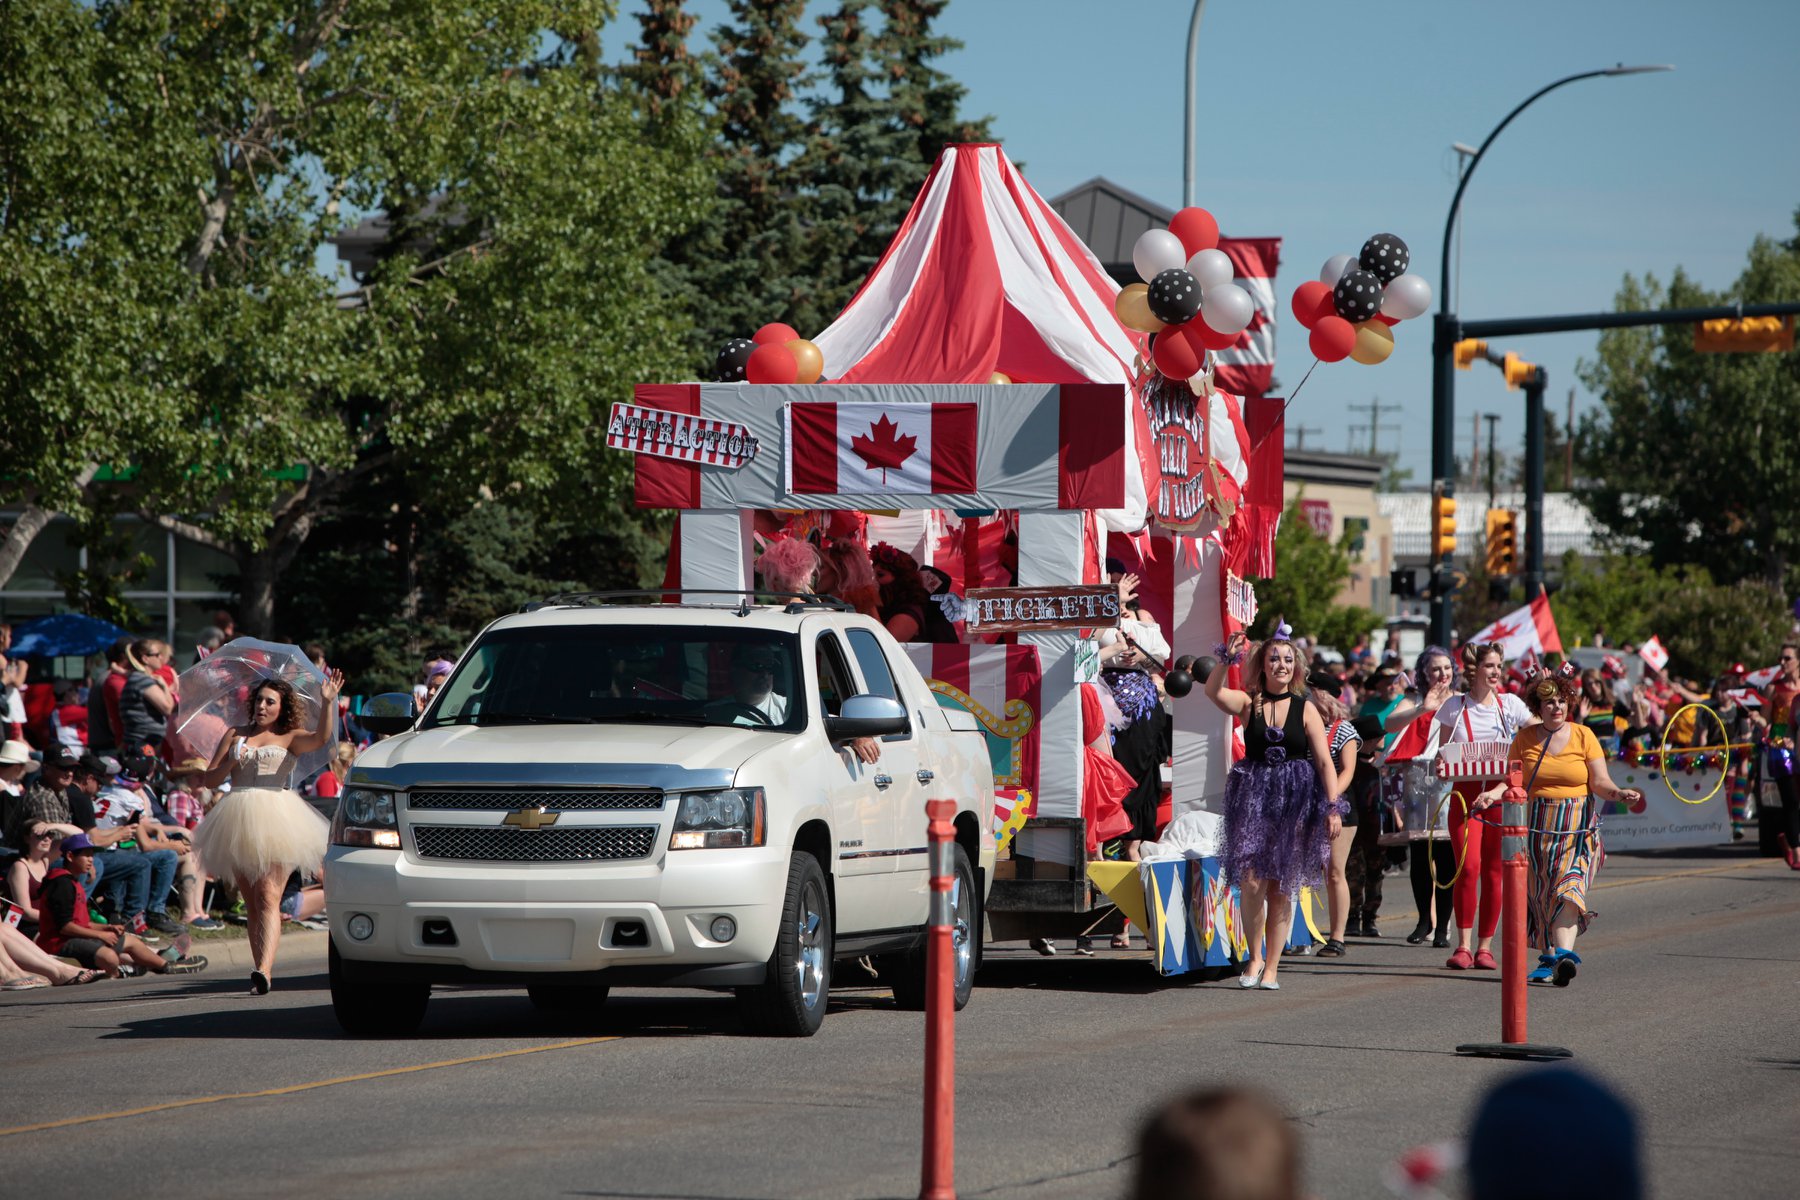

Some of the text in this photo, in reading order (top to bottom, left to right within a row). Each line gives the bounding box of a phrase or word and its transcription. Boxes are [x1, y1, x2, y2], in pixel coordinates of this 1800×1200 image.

[608, 414, 759, 460] ATTRACTION
[978, 593, 1120, 622] TICKETS
[1640, 826, 1649, 834] in
[1650, 825, 1667, 835] our
[1669, 821, 1723, 834] Community
